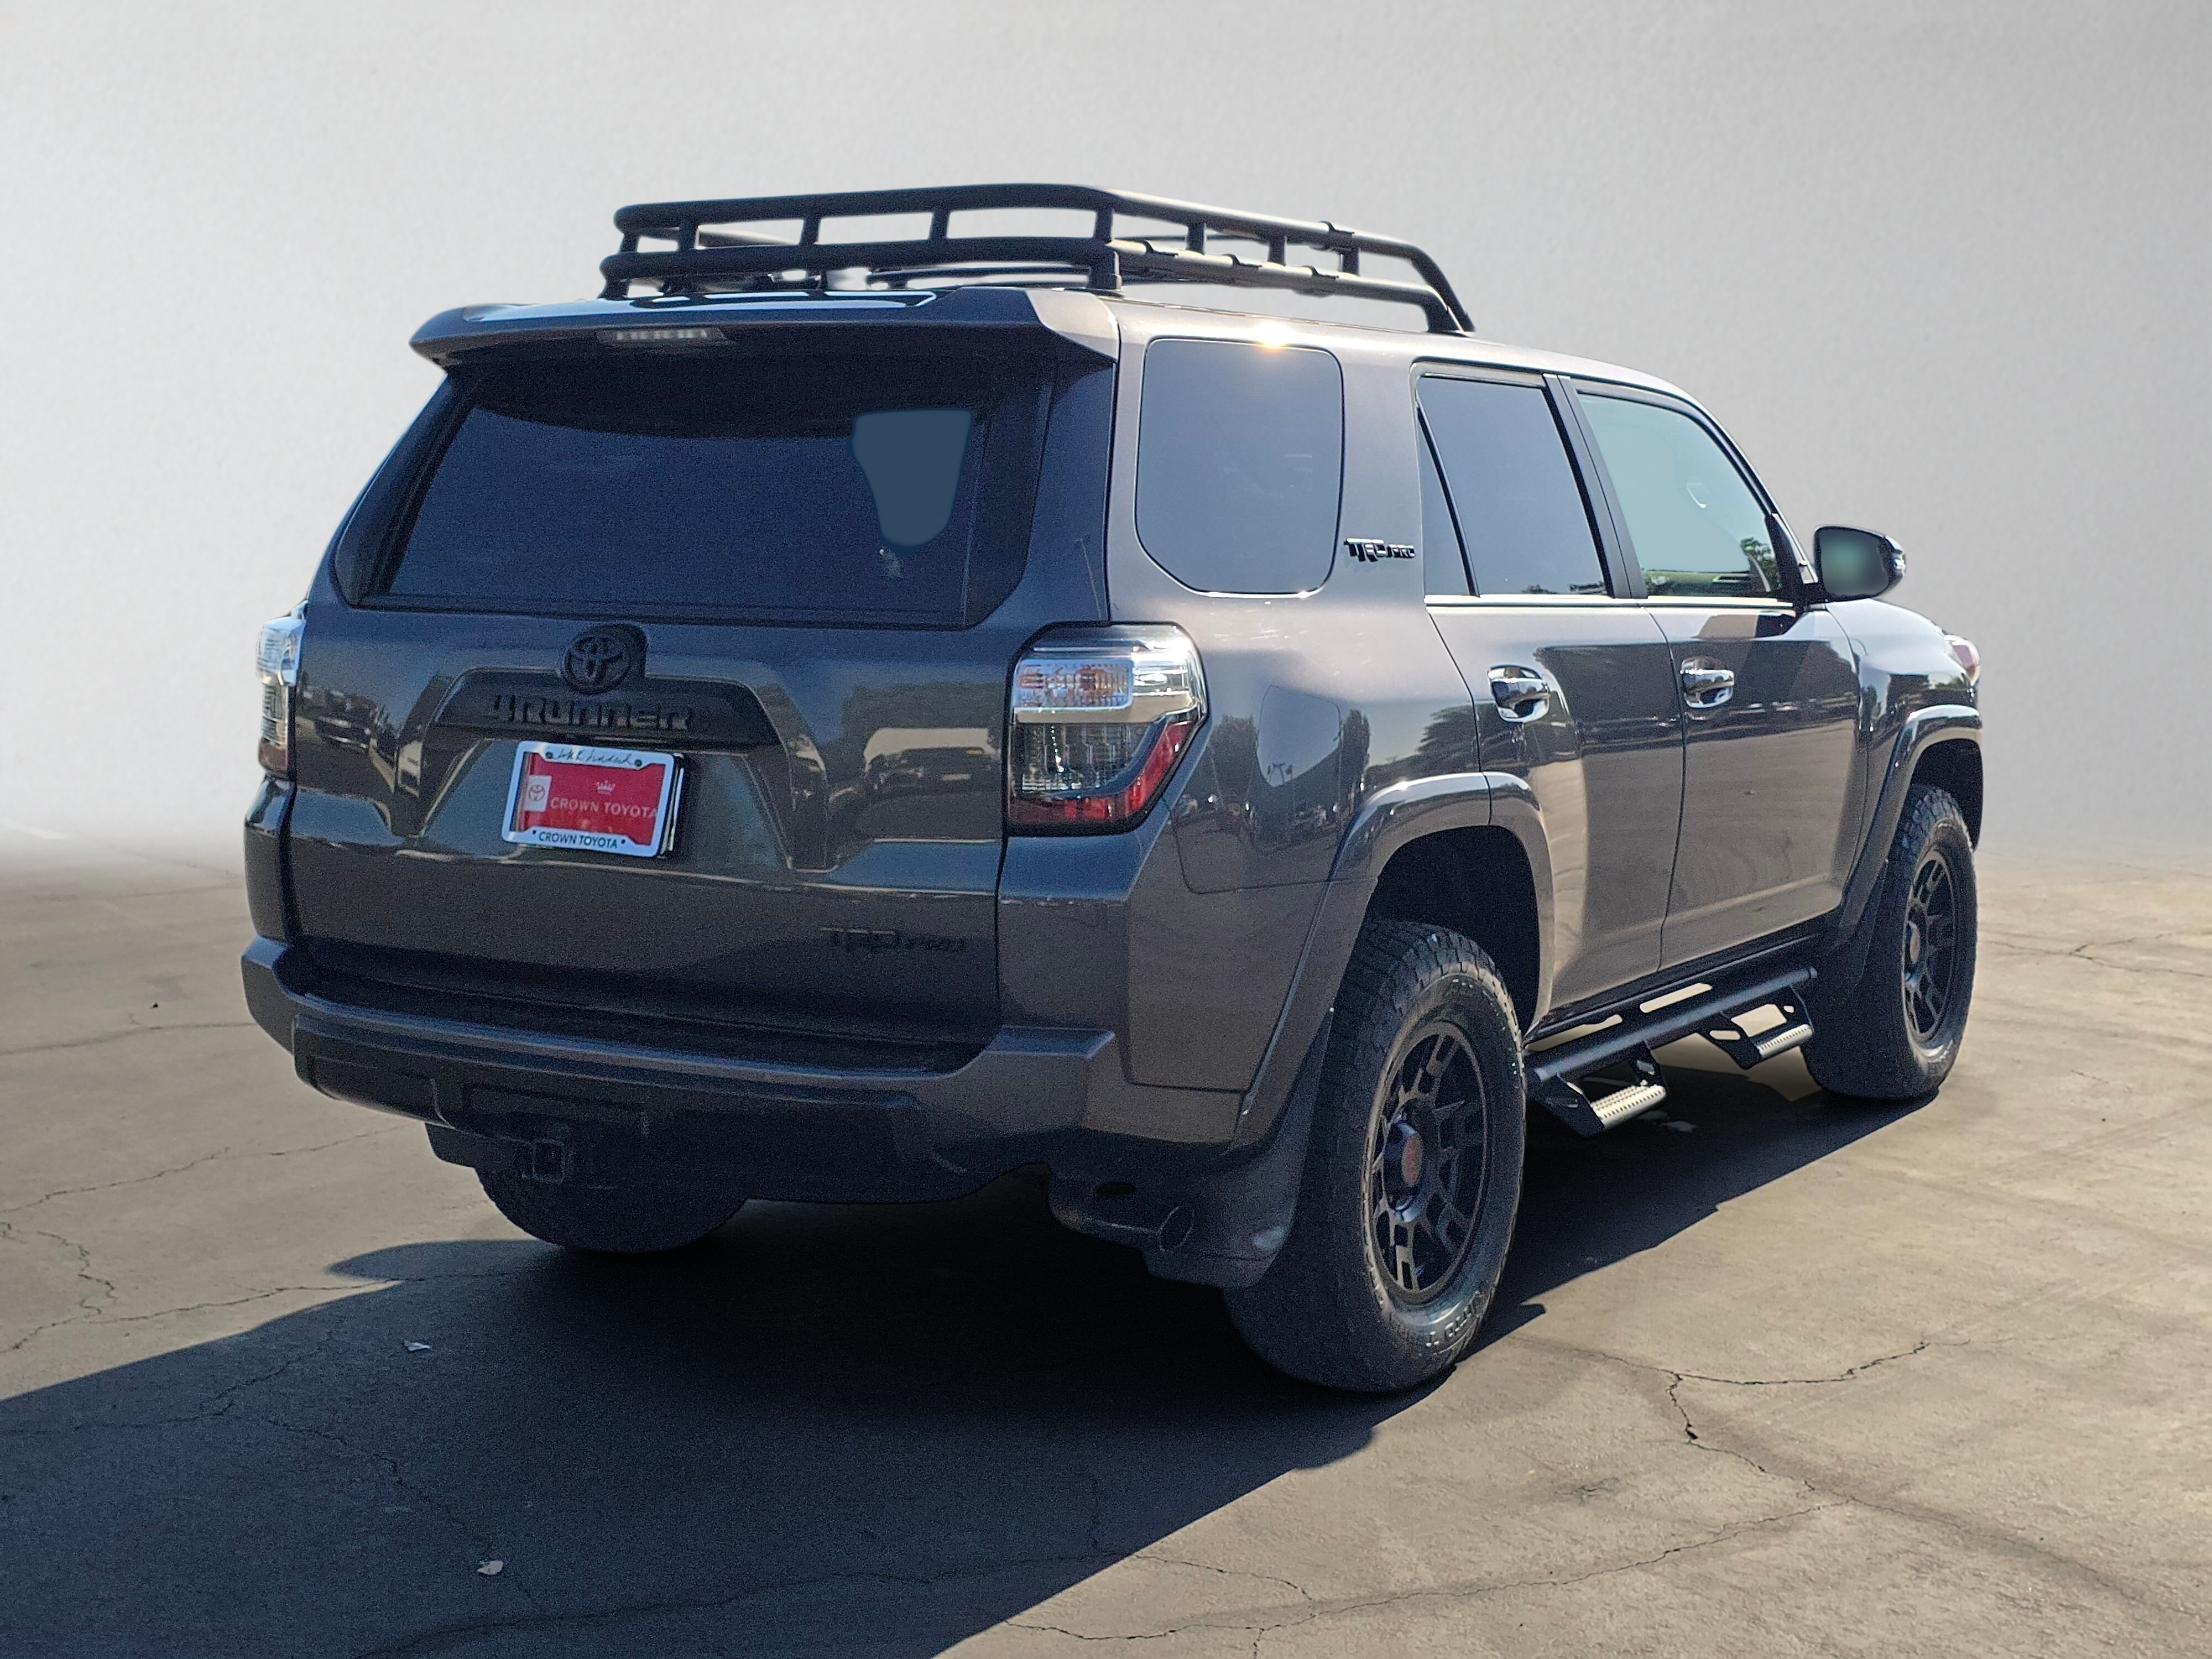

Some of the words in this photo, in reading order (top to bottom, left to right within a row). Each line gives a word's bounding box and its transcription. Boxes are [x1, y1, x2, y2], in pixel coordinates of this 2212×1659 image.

[550, 797, 599, 813] CROWN
[604, 803, 657, 818] TOYOTA
[539, 831, 577, 844] CROWN
[580, 834, 618, 849] TOYOTA
